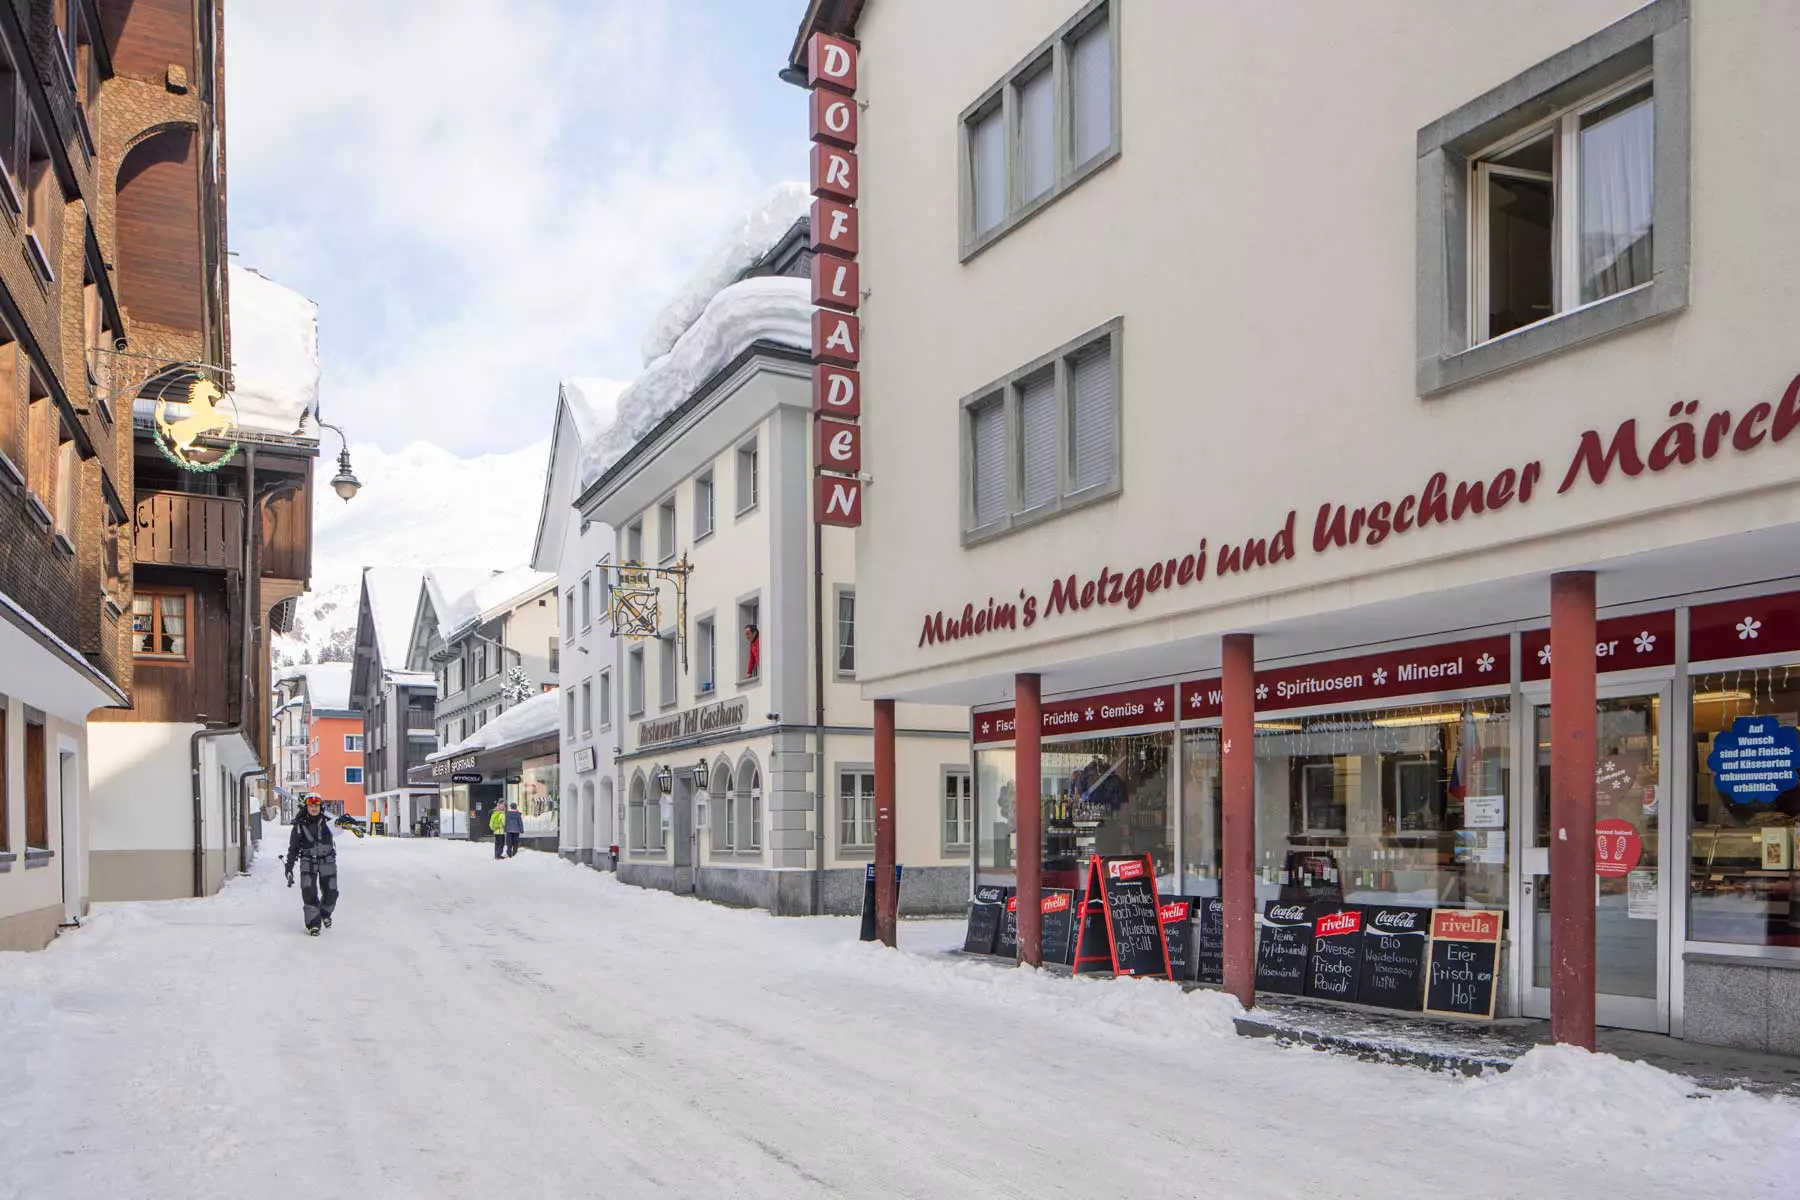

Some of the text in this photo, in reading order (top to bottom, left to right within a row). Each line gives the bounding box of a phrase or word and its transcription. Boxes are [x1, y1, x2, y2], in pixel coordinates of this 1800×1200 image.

[1043, 538, 1206, 619] Metzgerei
[1216, 510, 1296, 577] und
[1312, 460, 1541, 552] Urschner
[1276, 657, 1463, 699] Spirituosen Mineral
[640, 701, 743, 745] Restaurant Tell Gasthaus
[1043, 711, 1079, 727] Früchte
[1100, 703, 1144, 719] Gemüse
[1748, 724, 1764, 734] Auf
[1738, 735, 1774, 746] Wunsch
[1720, 746, 1793, 758] sind alle Fleisch-
[451, 756, 476, 772] SPORTHAUS
[1722, 759, 1791, 769] und Käsesorten
[1720, 770, 1793, 781] vakuumverpackt
[1733, 782, 1779, 793] erhältlich.
[1044, 895, 1066, 910] rivella
[1112, 903, 1131, 920] nach
[1119, 919, 1158, 936] Wünschen
[1321, 916, 1355, 931] rivella
[1441, 918, 1490, 933] rivella
[1117, 936, 1152, 962] gefüllt
[1315, 938, 1355, 958] Diverse
[1381, 937, 1400, 949] Bio
[1448, 944, 1476, 961] Eier
[1312, 955, 1352, 977] Frische
[1433, 961, 1473, 985] frisch
[1315, 973, 1349, 993] Ravioli
[1451, 982, 1477, 1010] Hof
